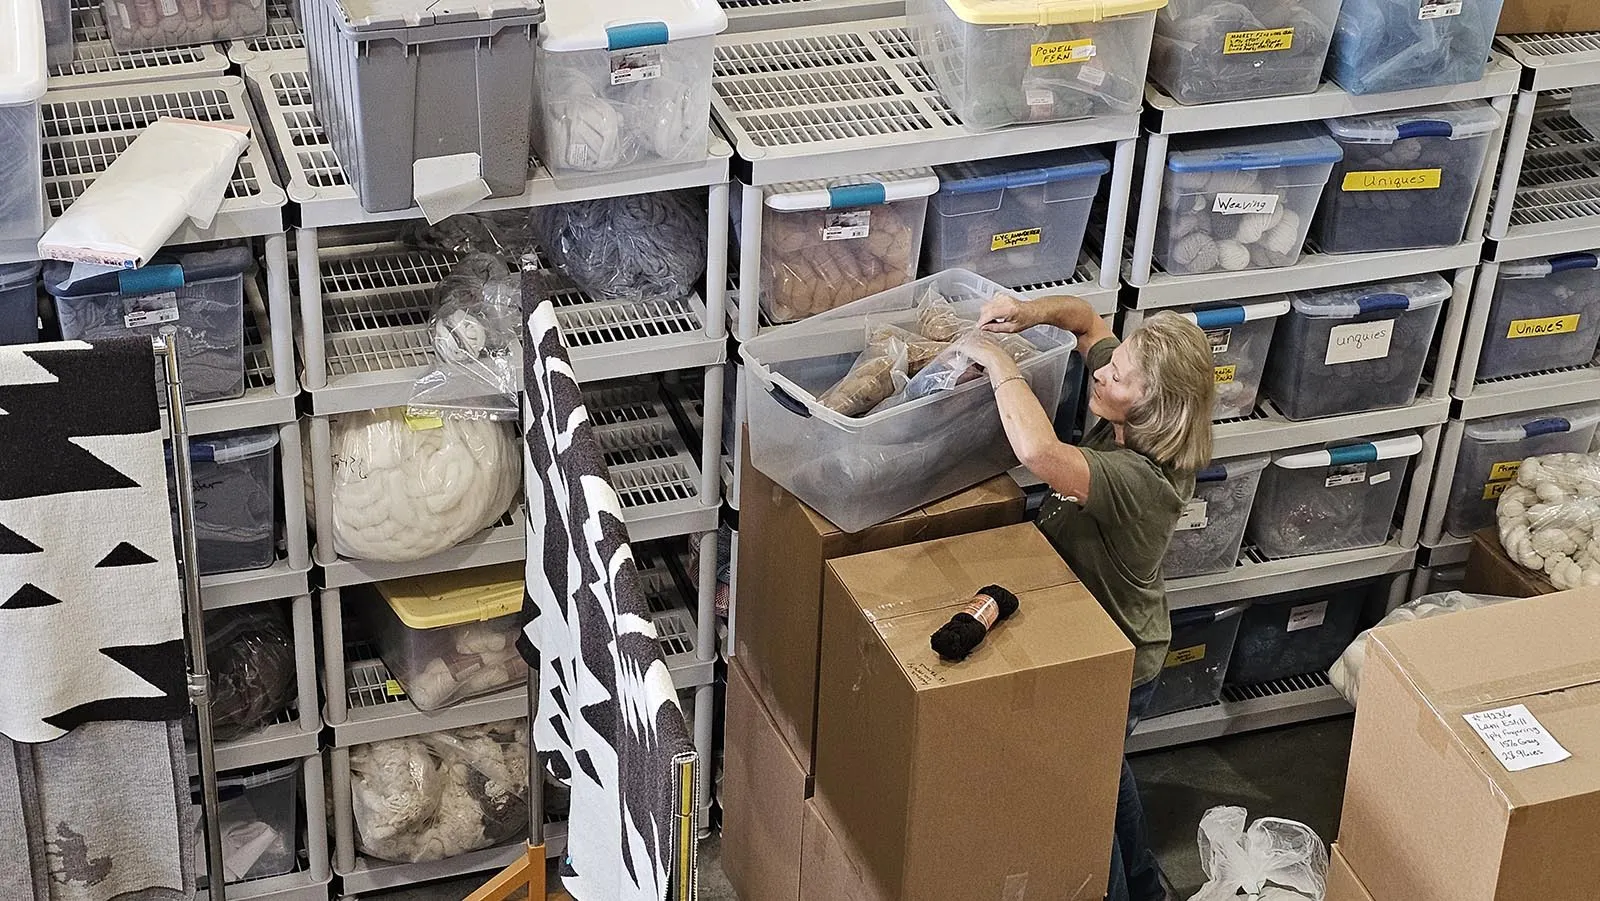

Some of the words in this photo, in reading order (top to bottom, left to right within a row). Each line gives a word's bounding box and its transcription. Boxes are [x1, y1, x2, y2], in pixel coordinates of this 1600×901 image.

[1035, 45, 1073, 56] POWELL
[1043, 53, 1070, 63] FERN
[1363, 174, 1427, 188] Uniques
[1217, 197, 1266, 212] Weaving
